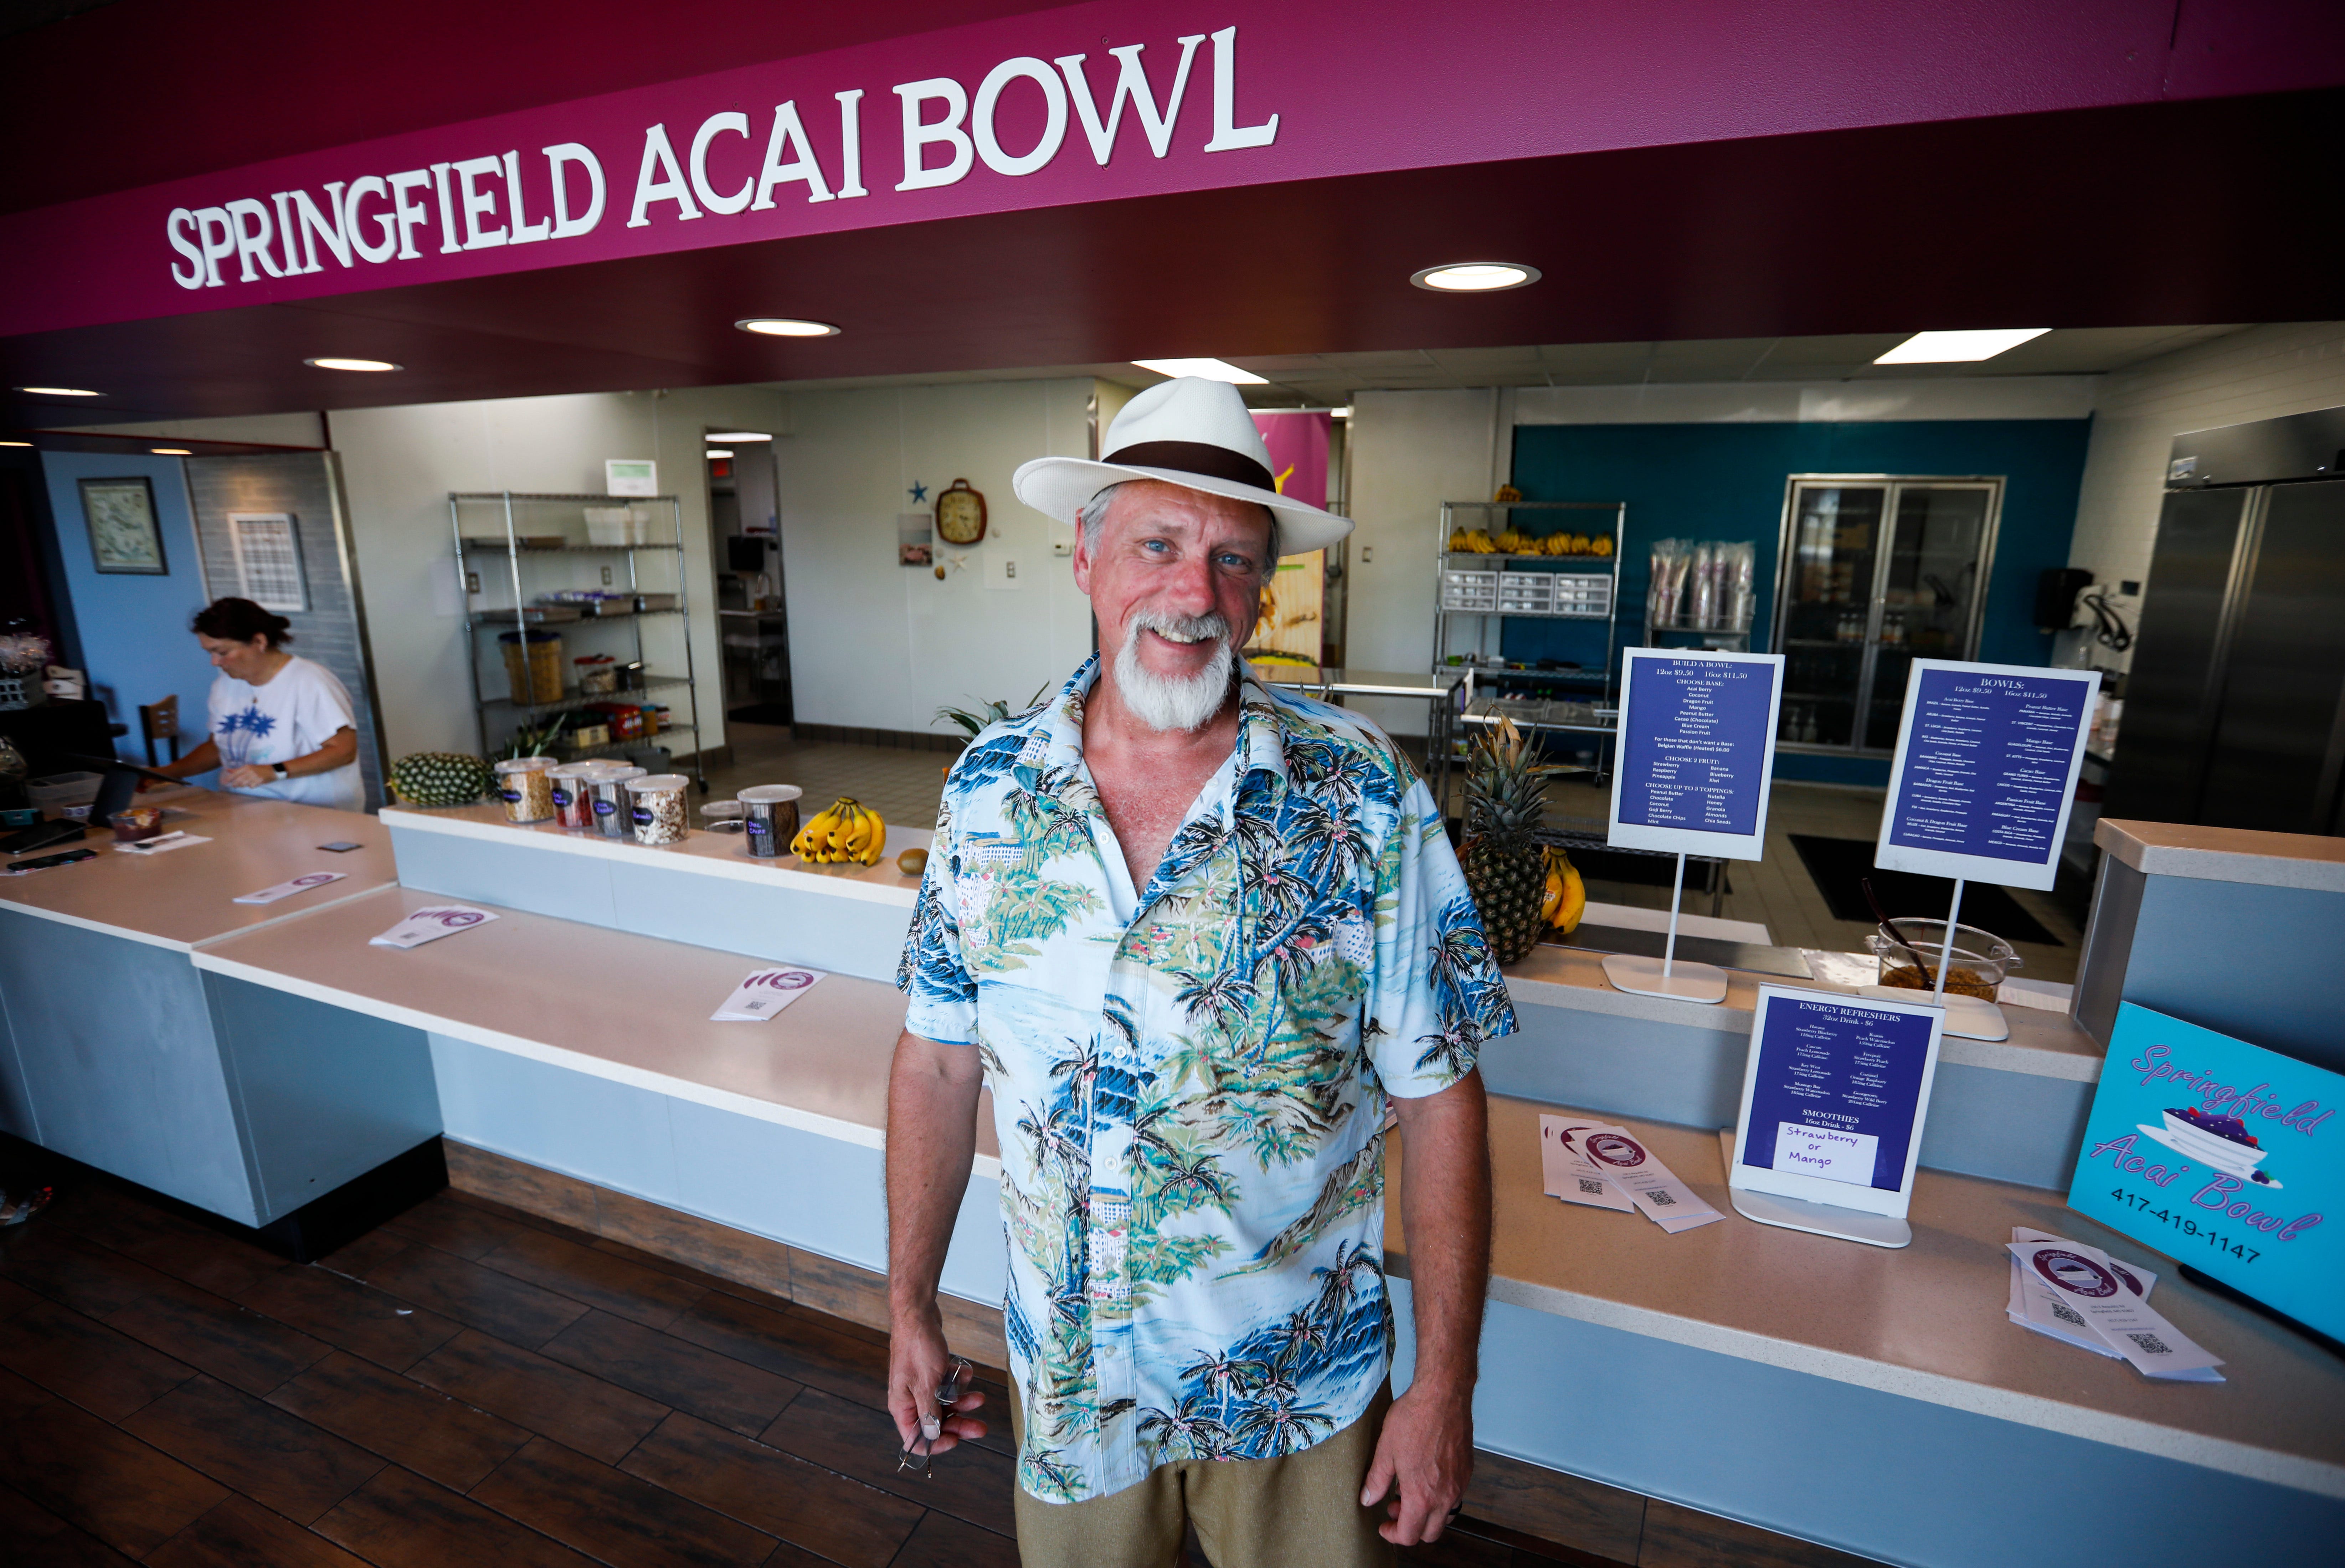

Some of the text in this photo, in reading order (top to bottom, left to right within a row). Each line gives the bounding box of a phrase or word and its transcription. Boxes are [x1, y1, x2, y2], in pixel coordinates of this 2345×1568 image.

[167, 25, 1279, 289] SPRINGFIELD ACAI BOWL
[1980, 678, 2024, 689] BOWLS:
[1800, 1002, 1901, 1022] ENERGY REFRESHERS
[2131, 1044, 2336, 1136] Springfield
[1802, 1109, 1859, 1124] SMOOTHIES
[1821, 1120, 1840, 1129] Drink
[1787, 1126, 1858, 1147] Strawberry
[1789, 1152, 1832, 1169] Mango
[2090, 1134, 2323, 1241] Acai Bowl
[2111, 1188, 2261, 1264] 417-419-1147
